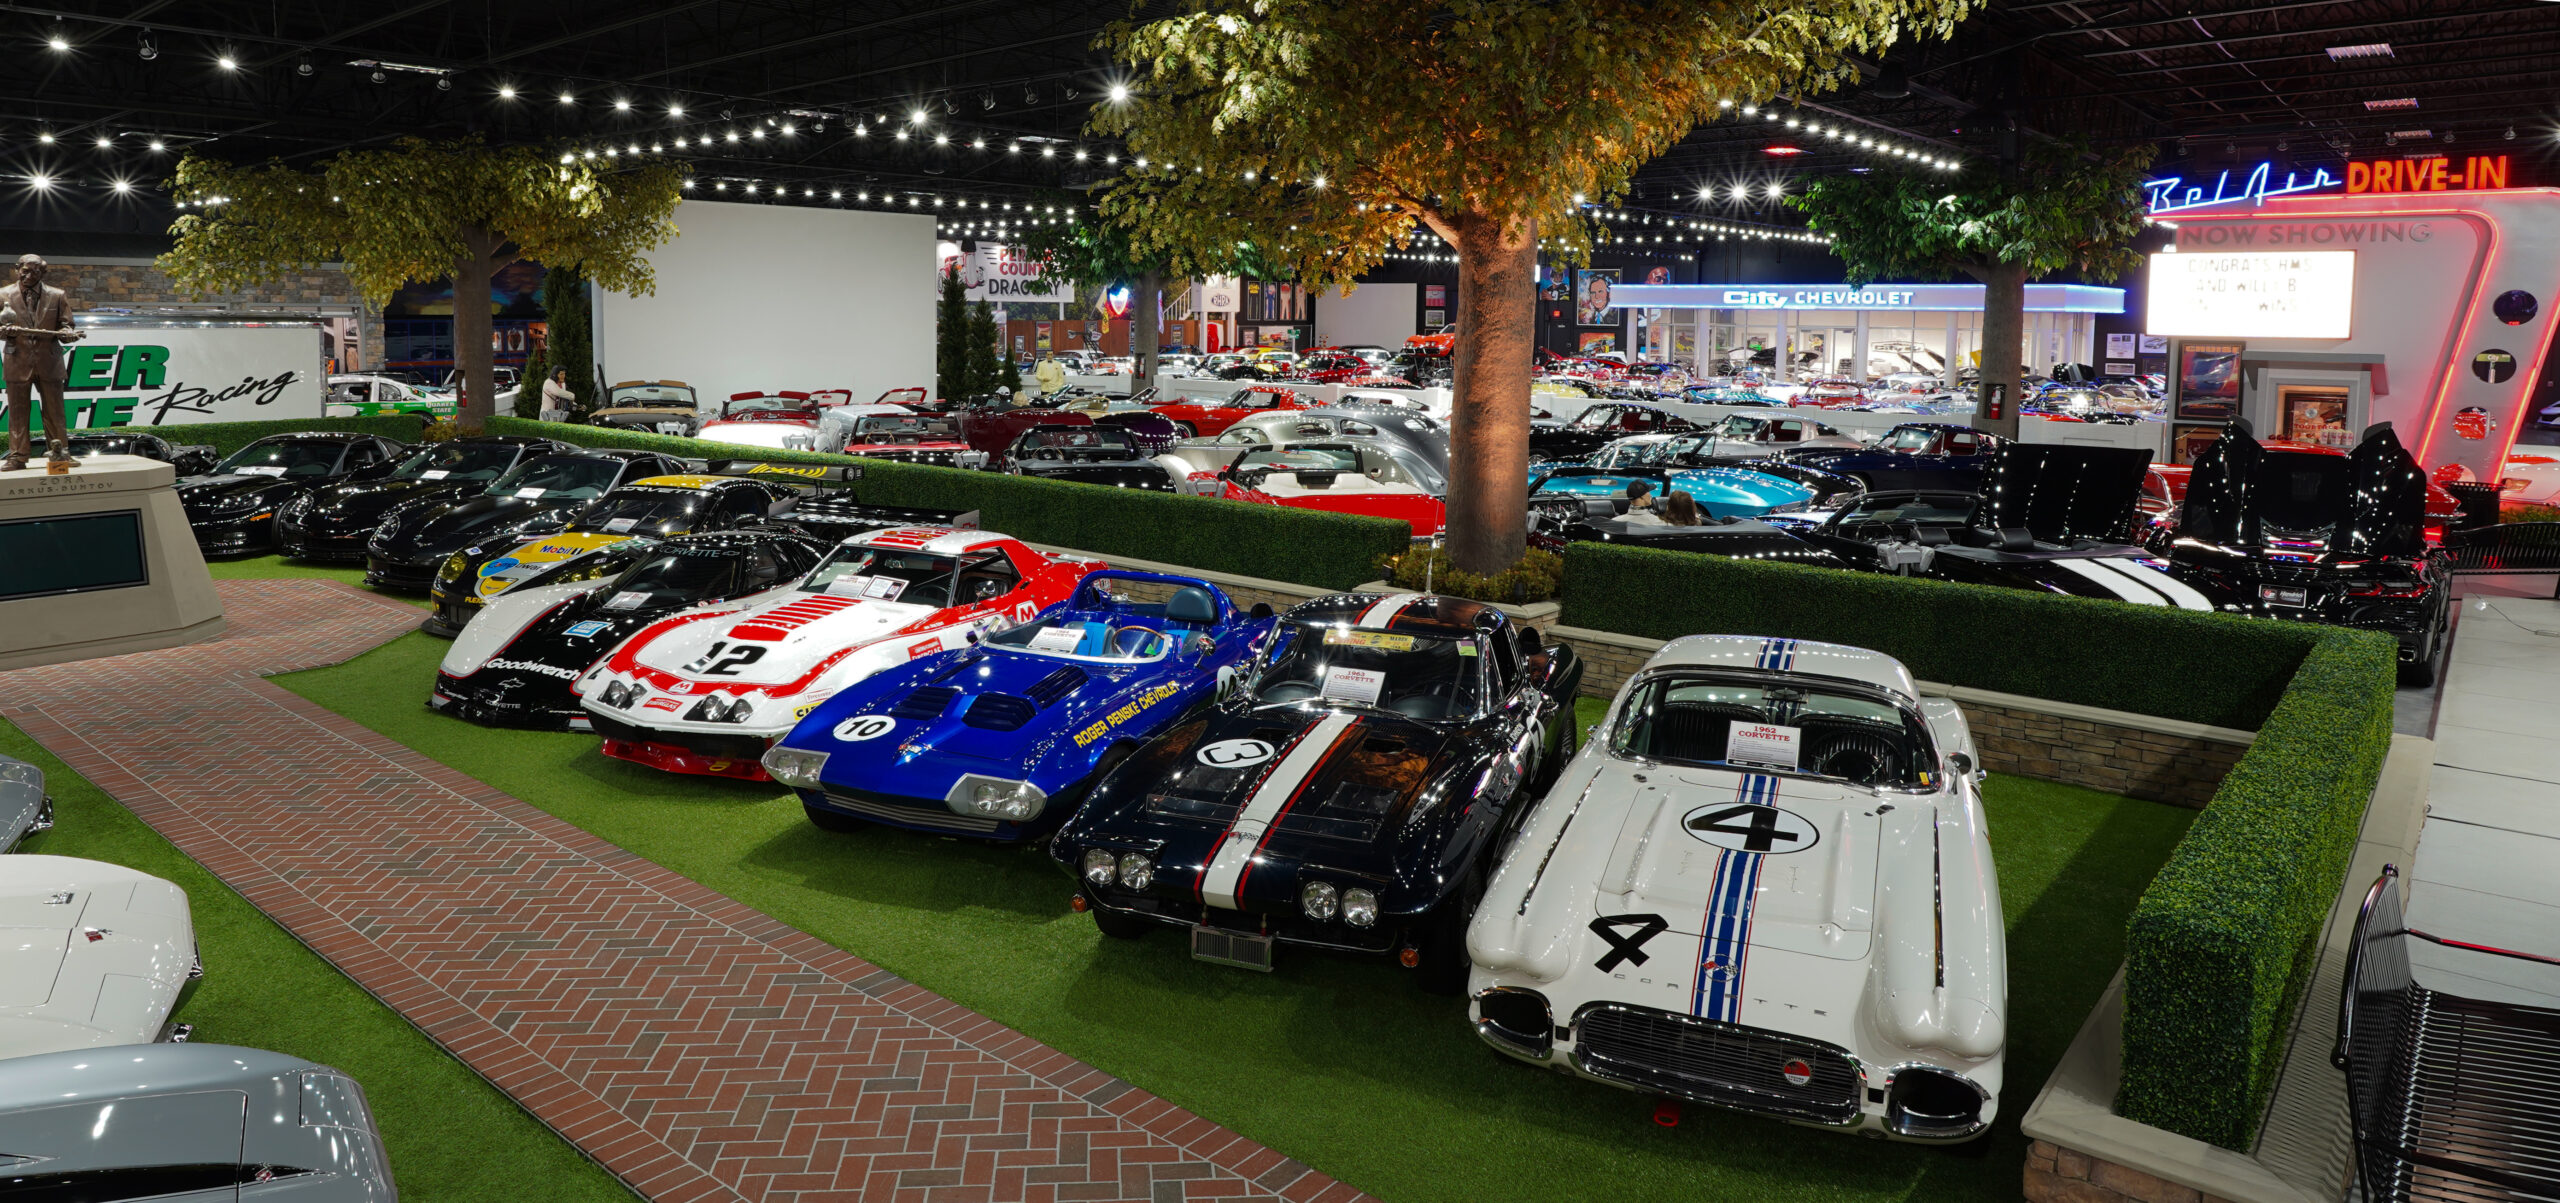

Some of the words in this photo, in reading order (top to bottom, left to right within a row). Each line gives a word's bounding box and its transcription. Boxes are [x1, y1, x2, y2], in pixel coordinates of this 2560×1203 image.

[2347, 155, 2508, 194] DRIVE-IN
[2182, 226, 2259, 245] NOW
[2268, 223, 2434, 244] SHOWING
[1000, 262, 1049, 276] COUNT
[1723, 291, 1788, 309] City
[1794, 291, 1914, 305] CHEVROLET
[143, 370, 299, 425] Racing
[39, 475, 85, 486] ZORA
[540, 545, 572, 555] Mobil
[659, 545, 721, 557] CORVETTE
[1020, 606, 1036, 622] M
[682, 641, 767, 676] 12
[486, 657, 582, 681] Goodwrench
[1334, 674, 1376, 683] CORVETTE
[1073, 720, 1110, 748] ROGER
[1106, 702, 1142, 729] PENSKE
[1138, 680, 1181, 710] CHEVROLET
[845, 718, 886, 736] 10
[1738, 730, 1790, 742] CORVETTE
[1754, 725, 1777, 733] 1962
[1203, 742, 1269, 764] 3
[1687, 804, 1799, 852] 4
[1588, 914, 1669, 974] 4
